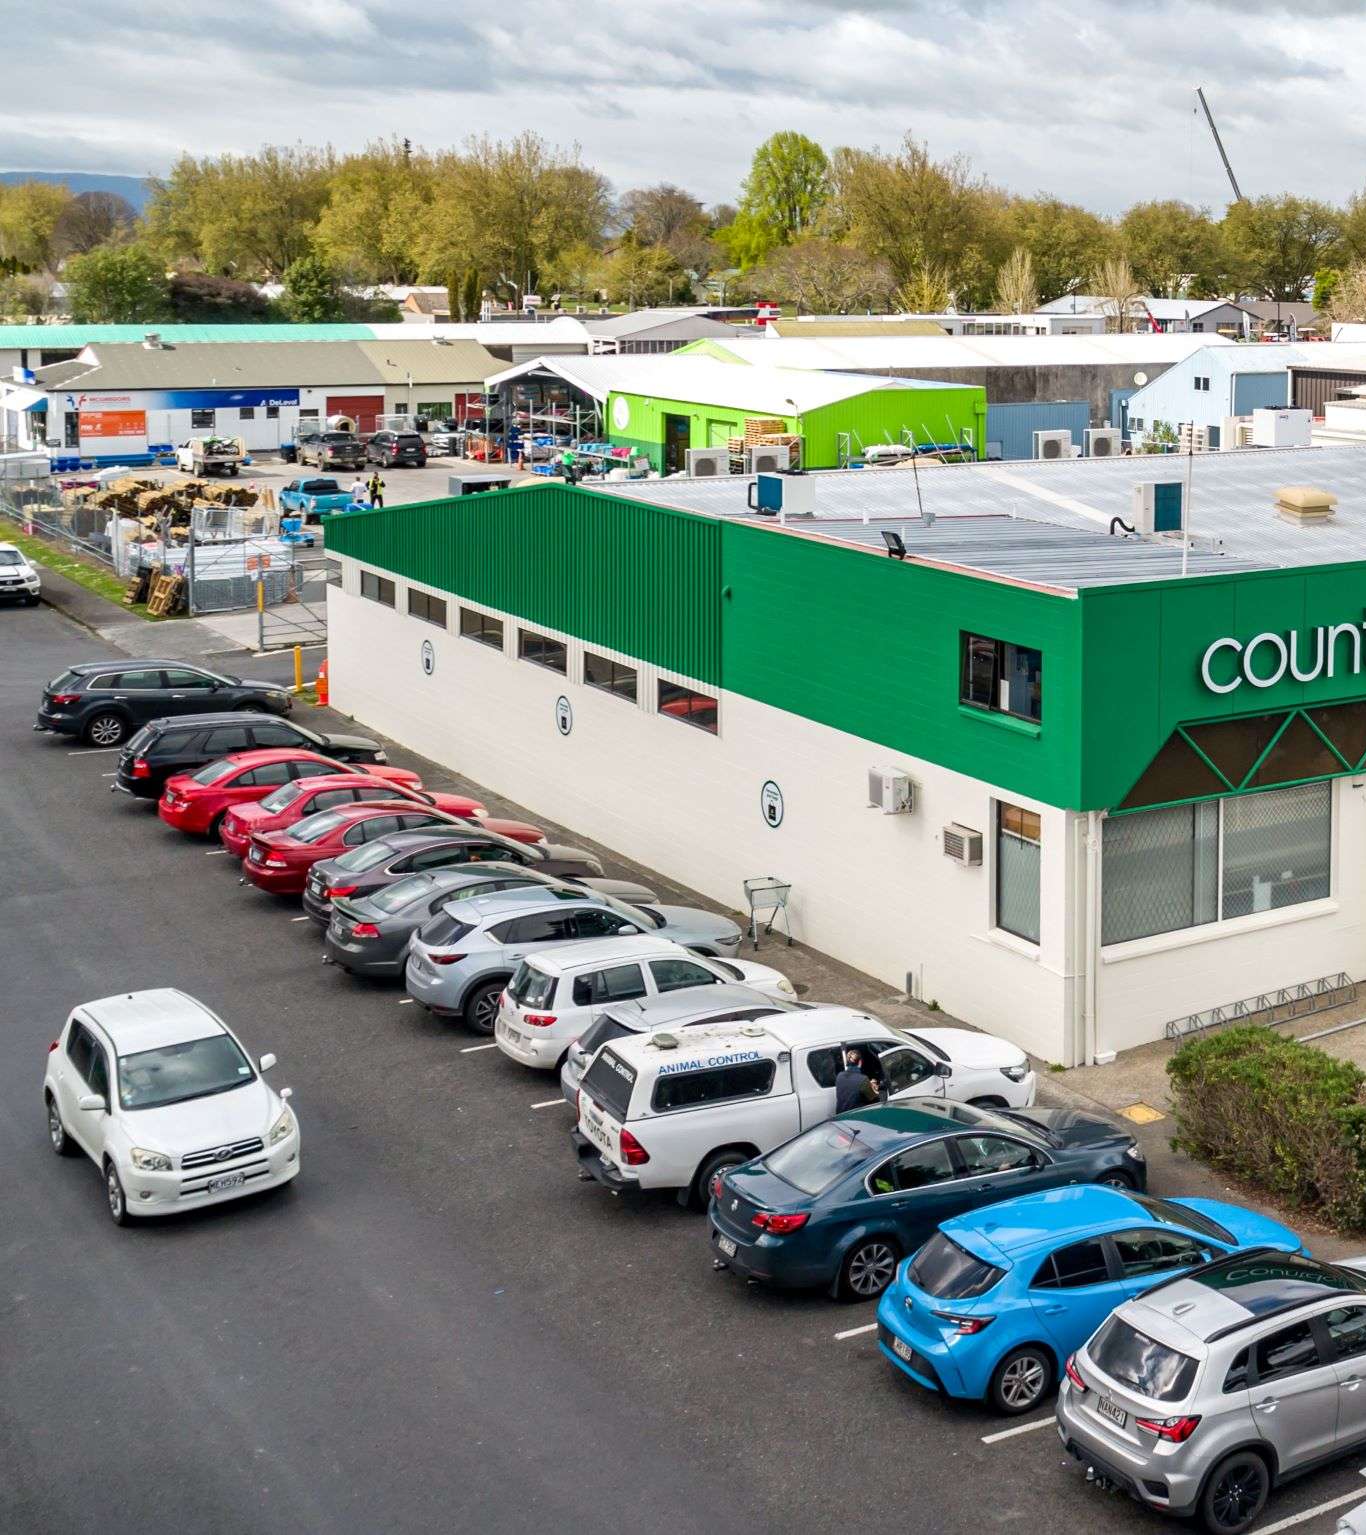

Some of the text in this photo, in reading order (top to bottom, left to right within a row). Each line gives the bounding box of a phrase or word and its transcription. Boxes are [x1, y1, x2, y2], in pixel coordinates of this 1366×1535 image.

[658, 1050, 764, 1075] ANIMAL CONTROL
[584, 1113, 613, 1151] TOYOTA
